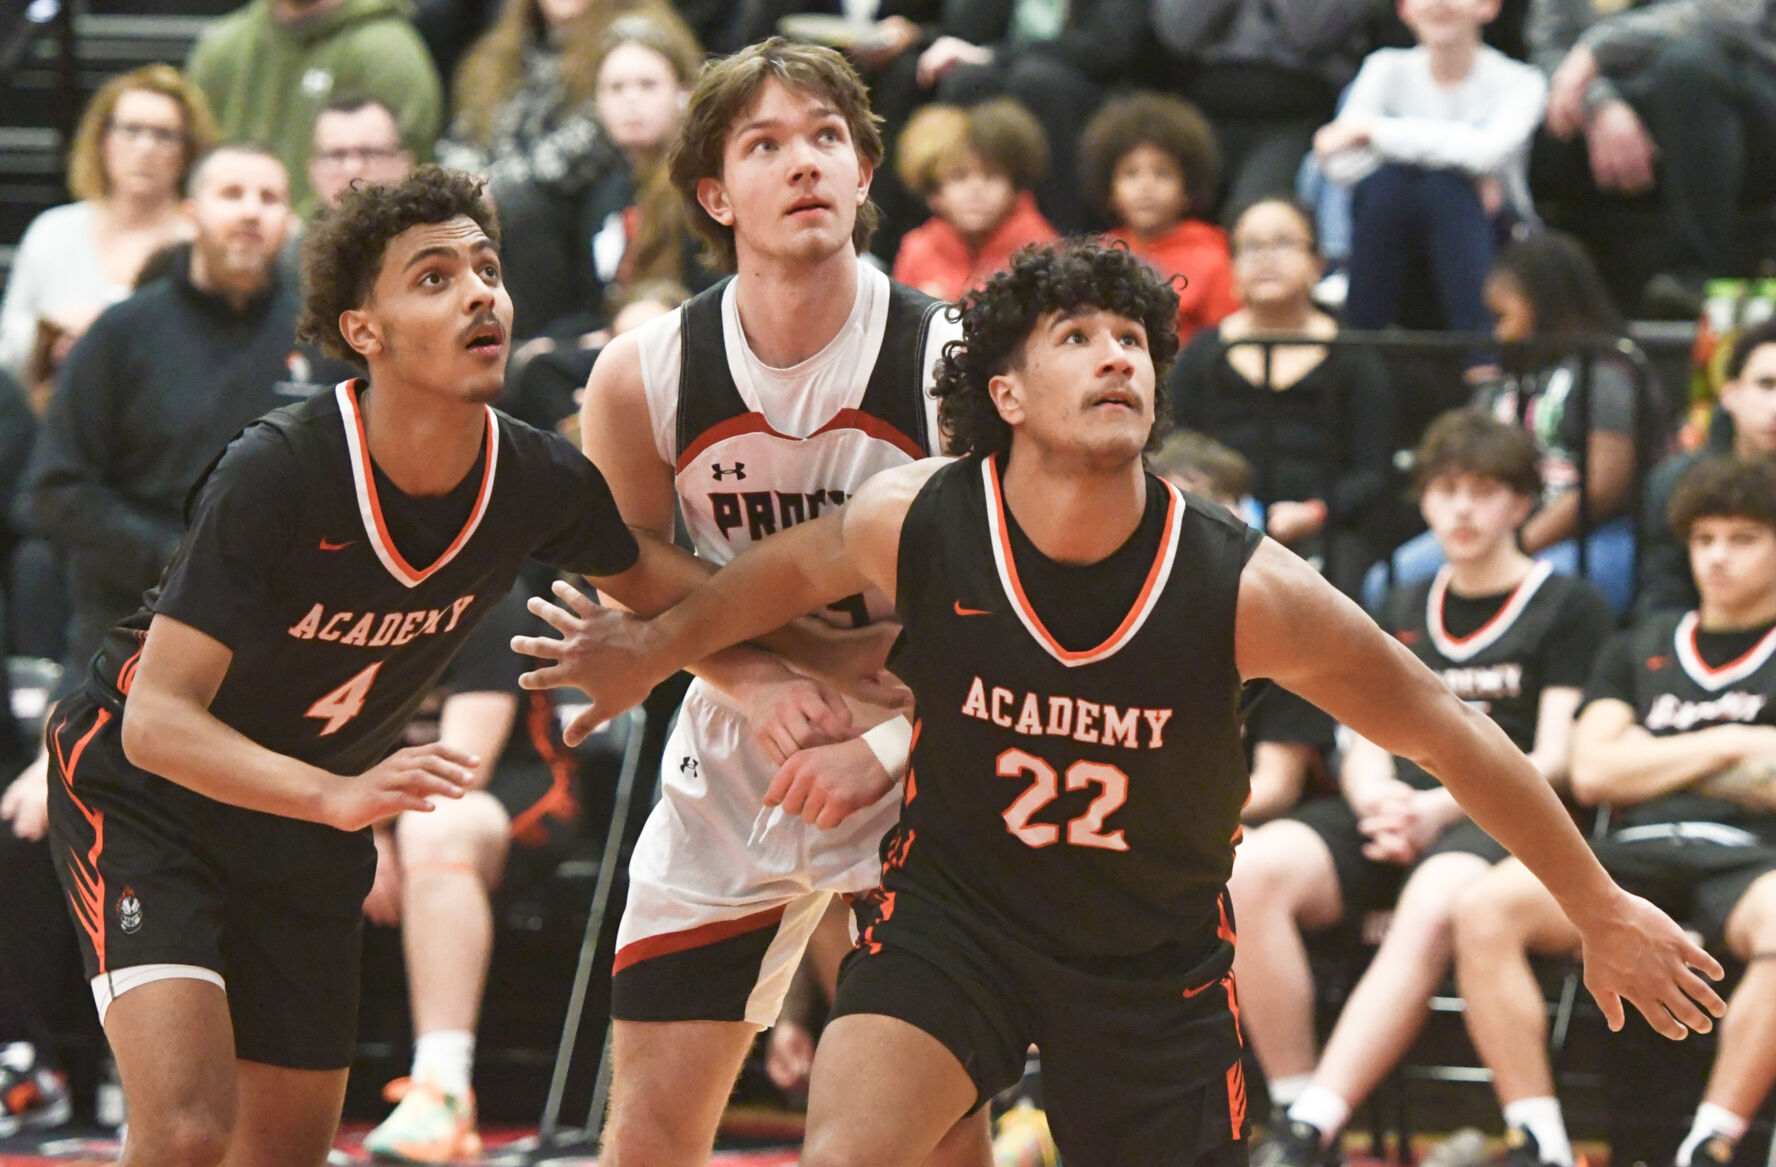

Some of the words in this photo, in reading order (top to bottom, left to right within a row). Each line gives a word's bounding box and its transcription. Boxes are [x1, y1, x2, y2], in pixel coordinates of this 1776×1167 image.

[303, 659, 385, 737] 4
[961, 674, 1173, 749] ACADEMY
[996, 747, 1130, 852] 22
